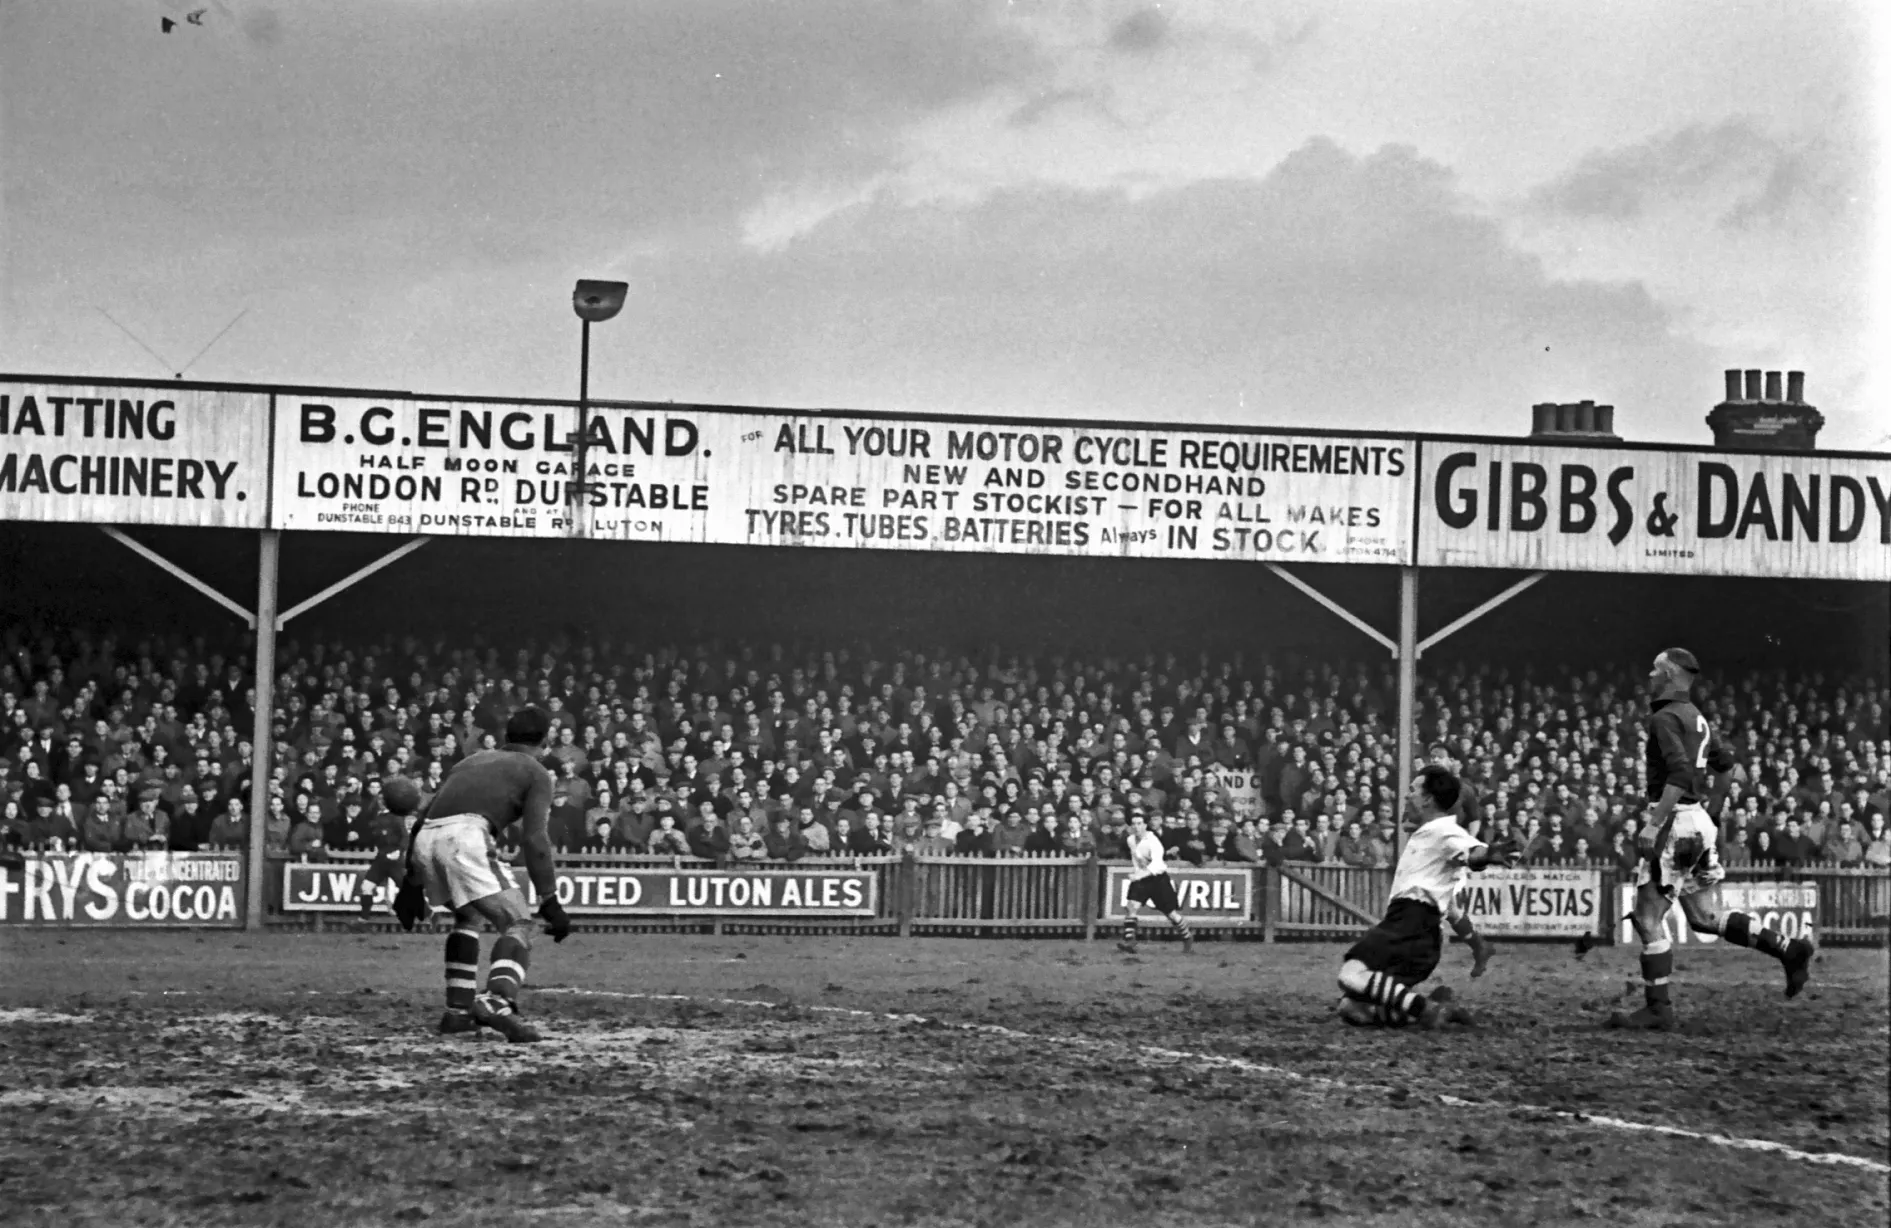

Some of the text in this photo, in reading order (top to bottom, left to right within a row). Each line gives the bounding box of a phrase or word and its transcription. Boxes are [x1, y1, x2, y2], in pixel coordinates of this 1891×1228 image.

[741, 430, 762, 442] FOR
[774, 423, 1405, 477] ALL YOUR MOTOR CYCLE REQUIREMENTS
[360, 454, 635, 477] HALF MOON GARAGE
[904, 464, 1265, 498] NEW AND SECONDHAND
[298, 471, 442, 502] LONDON
[516, 479, 709, 510] DUNSTABLE
[773, 484, 866, 507] SPARE
[883, 489, 959, 510] PART
[973, 492, 1107, 516] STOCKIST
[1149, 499, 1202, 520] FOR
[1217, 502, 1270, 523] ALL
[1287, 505, 1380, 527] MAKES
[1435, 452, 1634, 547] GIBBS
[1646, 492, 1678, 537] &
[318, 513, 411, 525] DUNSTABLE 843
[342, 503, 379, 513] PHONE
[421, 514, 536, 529] DUNSTABLE
[595, 520, 663, 532] LUTON
[944, 517, 1090, 546] BATTERIES
[1101, 527, 1157, 544] Always
[1168, 525, 1197, 550] IN
[1645, 549, 1694, 558] LIMITED
[1696, 715, 1710, 768] 2
[670, 877, 771, 906] LUTON
[782, 877, 863, 907] ALES
[1544, 873, 1581, 881] MATCH
[125, 882, 237, 920] COCOA
[1456, 886, 1501, 915] WAN
[1509, 884, 1593, 917] VESTAS
